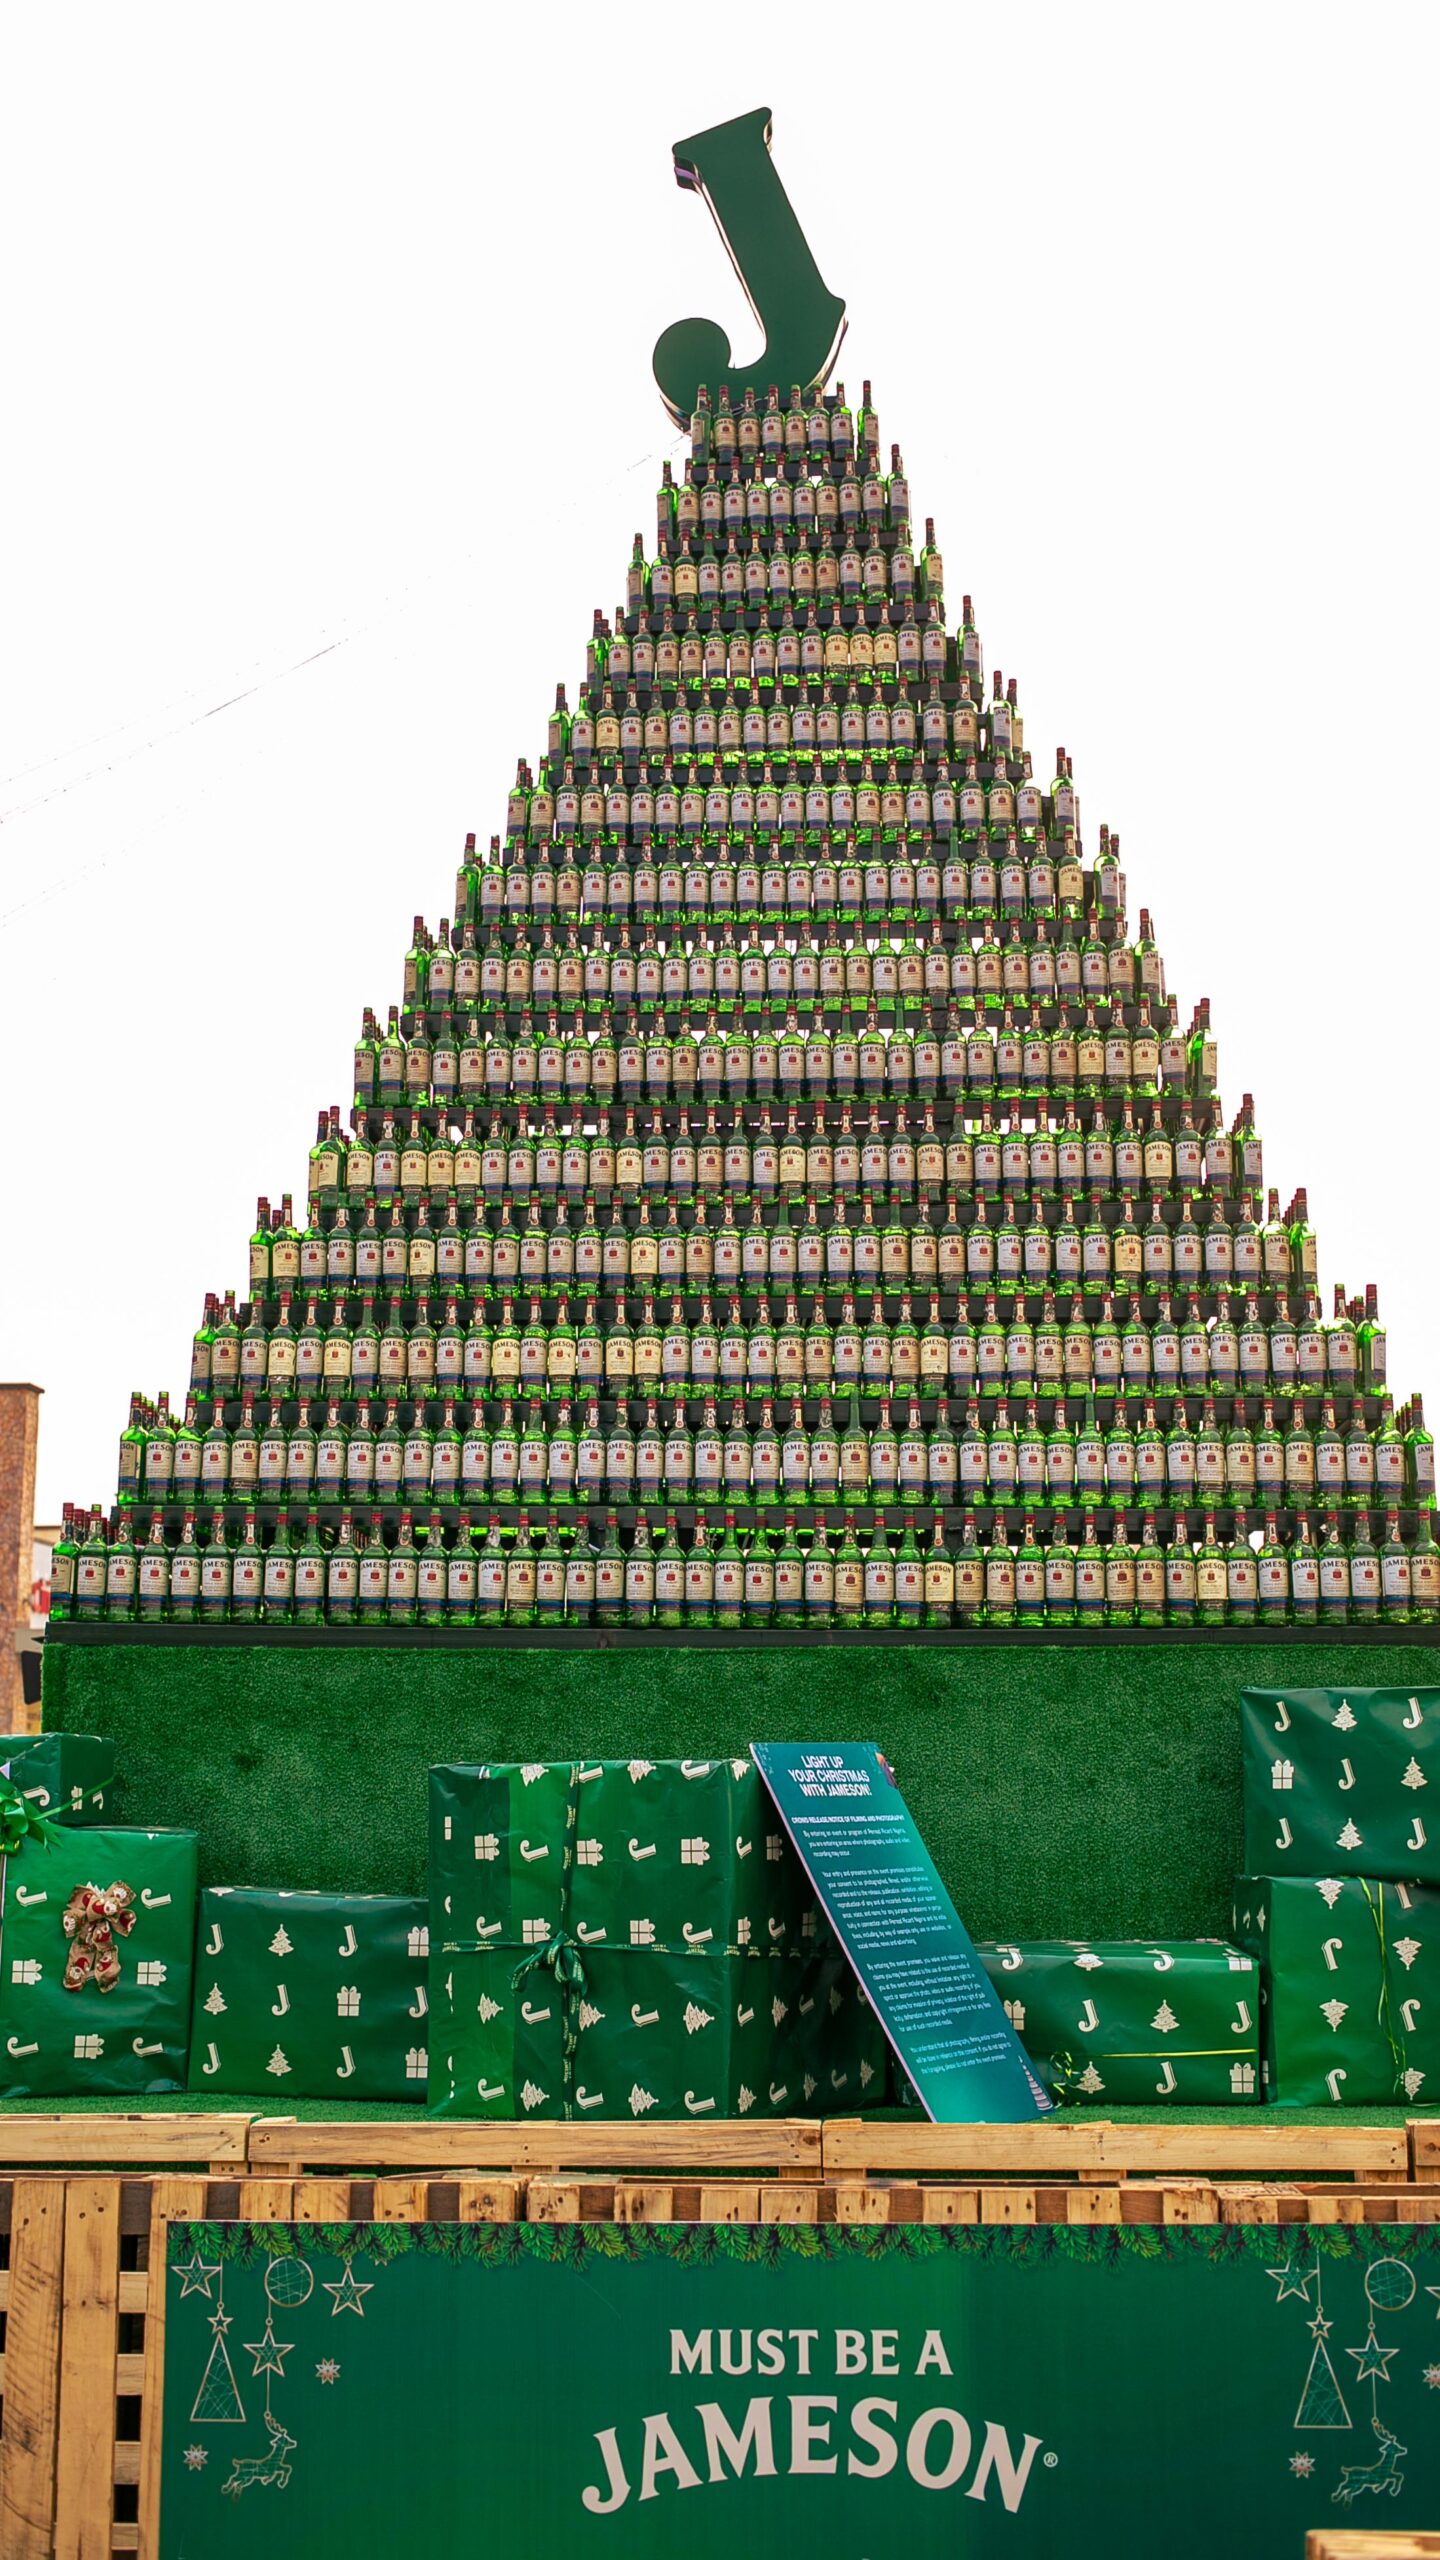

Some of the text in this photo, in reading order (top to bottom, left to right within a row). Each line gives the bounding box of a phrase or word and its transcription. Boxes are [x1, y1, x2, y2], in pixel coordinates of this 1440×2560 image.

[652, 106, 847, 425] J
[801, 1755, 844, 1768] LIGHT UP
[788, 1769, 870, 1782] YOUR CHRISTMAS
[799, 1784, 872, 1797] WITH JAMESON!
[669, 2328, 954, 2376] MUST BE A
